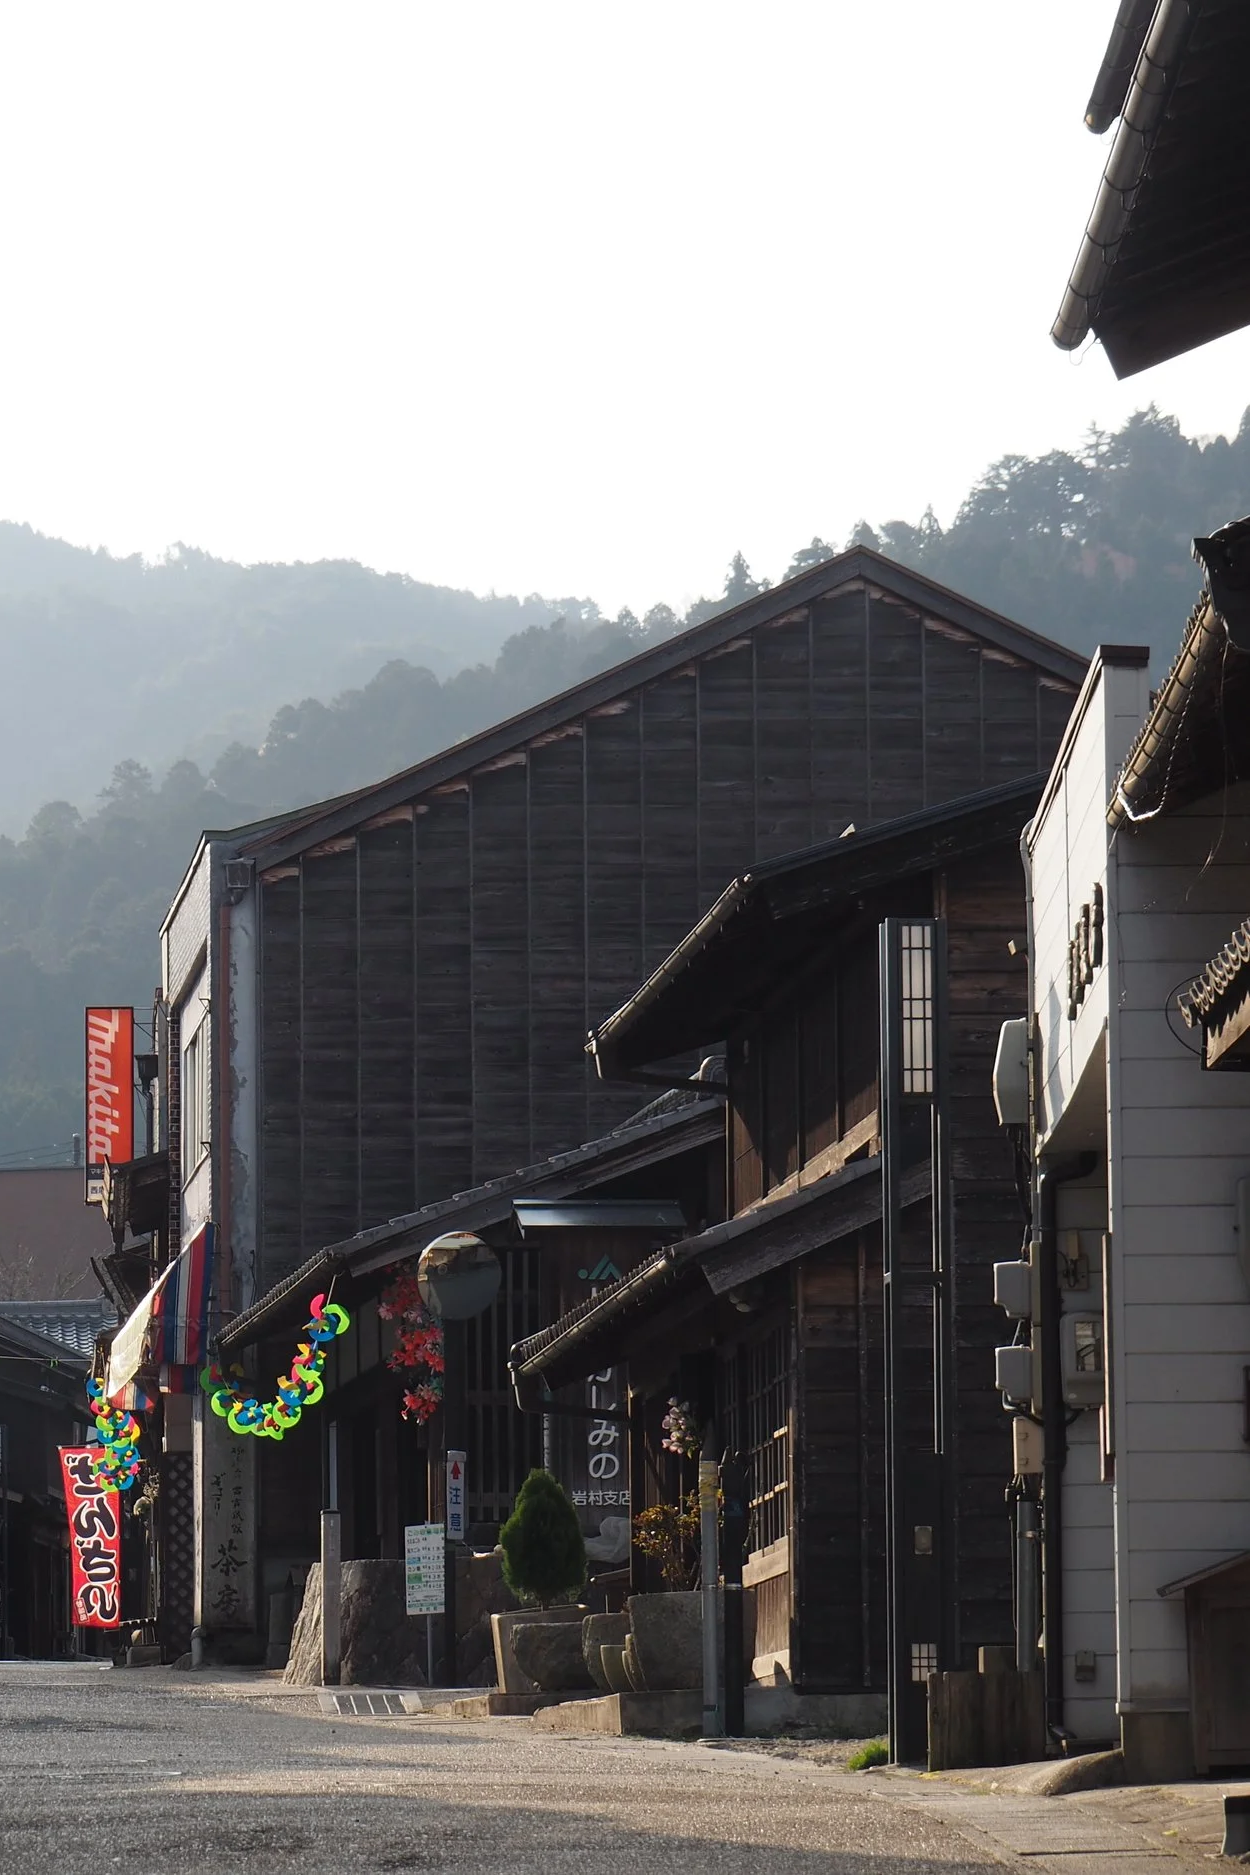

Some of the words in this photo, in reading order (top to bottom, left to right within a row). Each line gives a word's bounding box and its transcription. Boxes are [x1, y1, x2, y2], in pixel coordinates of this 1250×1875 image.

[88, 1009, 119, 1164] makita
[449, 1486, 462, 1532] 注意
[572, 1490, 630, 1506] 岩村支店
